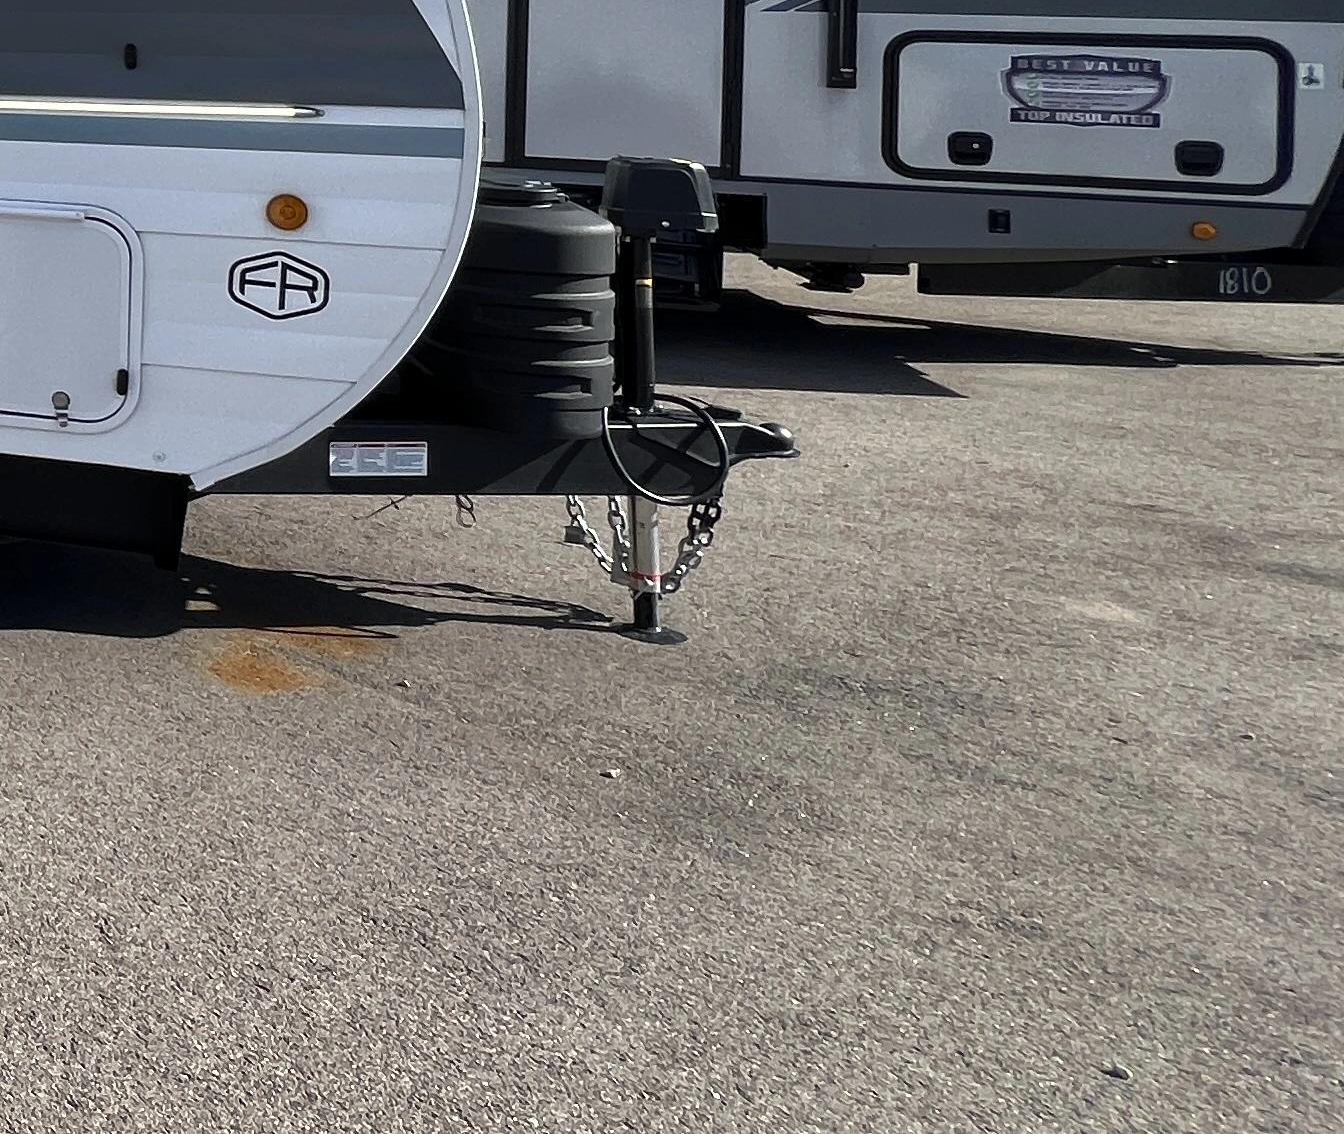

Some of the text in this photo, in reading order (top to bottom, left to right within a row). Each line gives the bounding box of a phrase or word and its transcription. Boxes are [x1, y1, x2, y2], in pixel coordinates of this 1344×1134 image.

[1017, 58, 1156, 74] BEST VALUE
[1017, 110, 1154, 126] TOP INSULATED
[238, 259, 319, 311] FR
[1218, 266, 1272, 295] 1810
